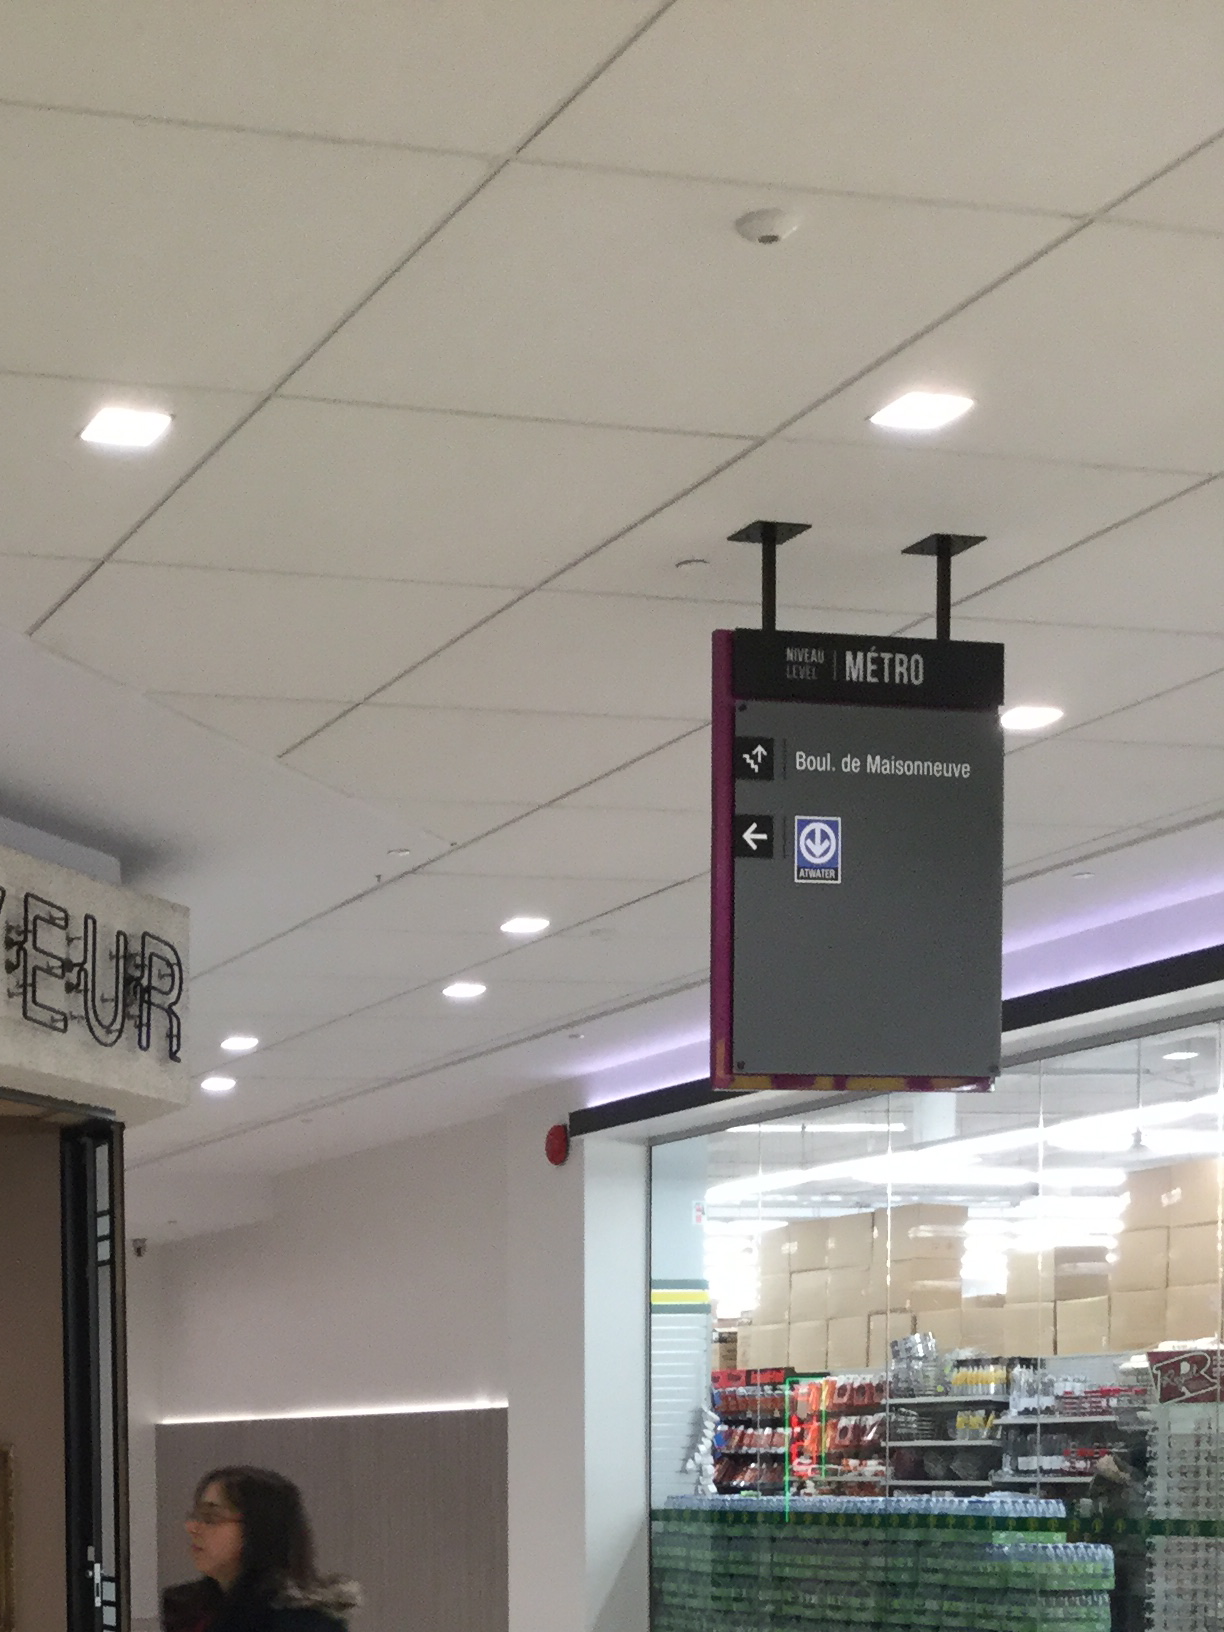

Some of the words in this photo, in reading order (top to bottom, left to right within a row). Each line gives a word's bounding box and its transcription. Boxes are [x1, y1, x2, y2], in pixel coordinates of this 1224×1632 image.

[785, 646, 825, 665] NIVEAU
[785, 664, 819, 680] LEVEL
[845, 645, 925, 686] MÉTRO
[795, 750, 836, 772] Boul.
[841, 753, 861, 773] de
[866, 753, 972, 779] Maisonneuve
[798, 867, 836, 879] ATWATER
